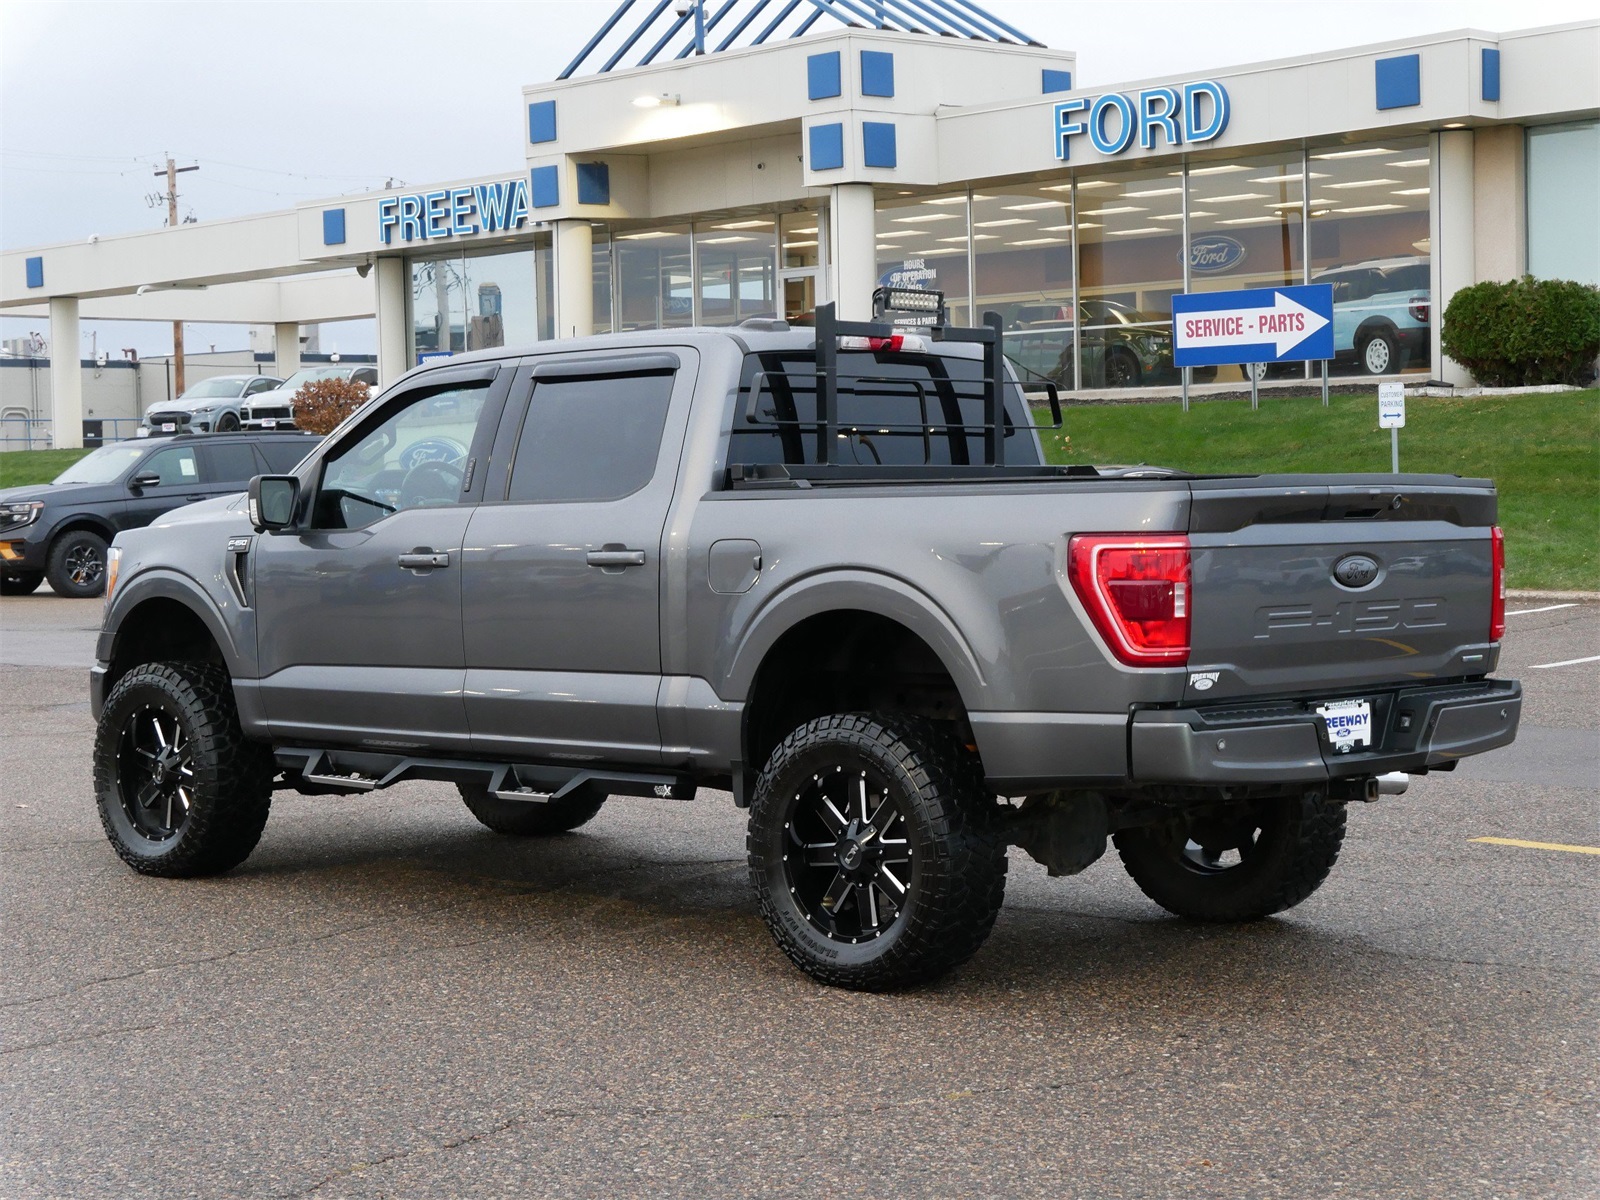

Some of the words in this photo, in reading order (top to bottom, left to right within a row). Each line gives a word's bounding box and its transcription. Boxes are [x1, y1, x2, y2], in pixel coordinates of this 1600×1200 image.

[1053, 81, 1230, 160] FORD
[378, 179, 529, 244] FREEWA
[1190, 243, 1229, 266] Ford
[903, 259, 925, 270] HOURS
[902, 269, 937, 281] OPERATION
[922, 316, 938, 325] PARTS
[1185, 317, 1244, 338] SERVICE
[1259, 312, 1305, 334] PARTS
[1380, 391, 1403, 399] CUSTOMER
[1380, 400, 1403, 408] PARKING
[1346, 561, 1371, 580] Ford
[1253, 596, 1448, 639] F-150
[1189, 671, 1220, 686] FREEWAY
[1324, 712, 1369, 729] REEWAY
